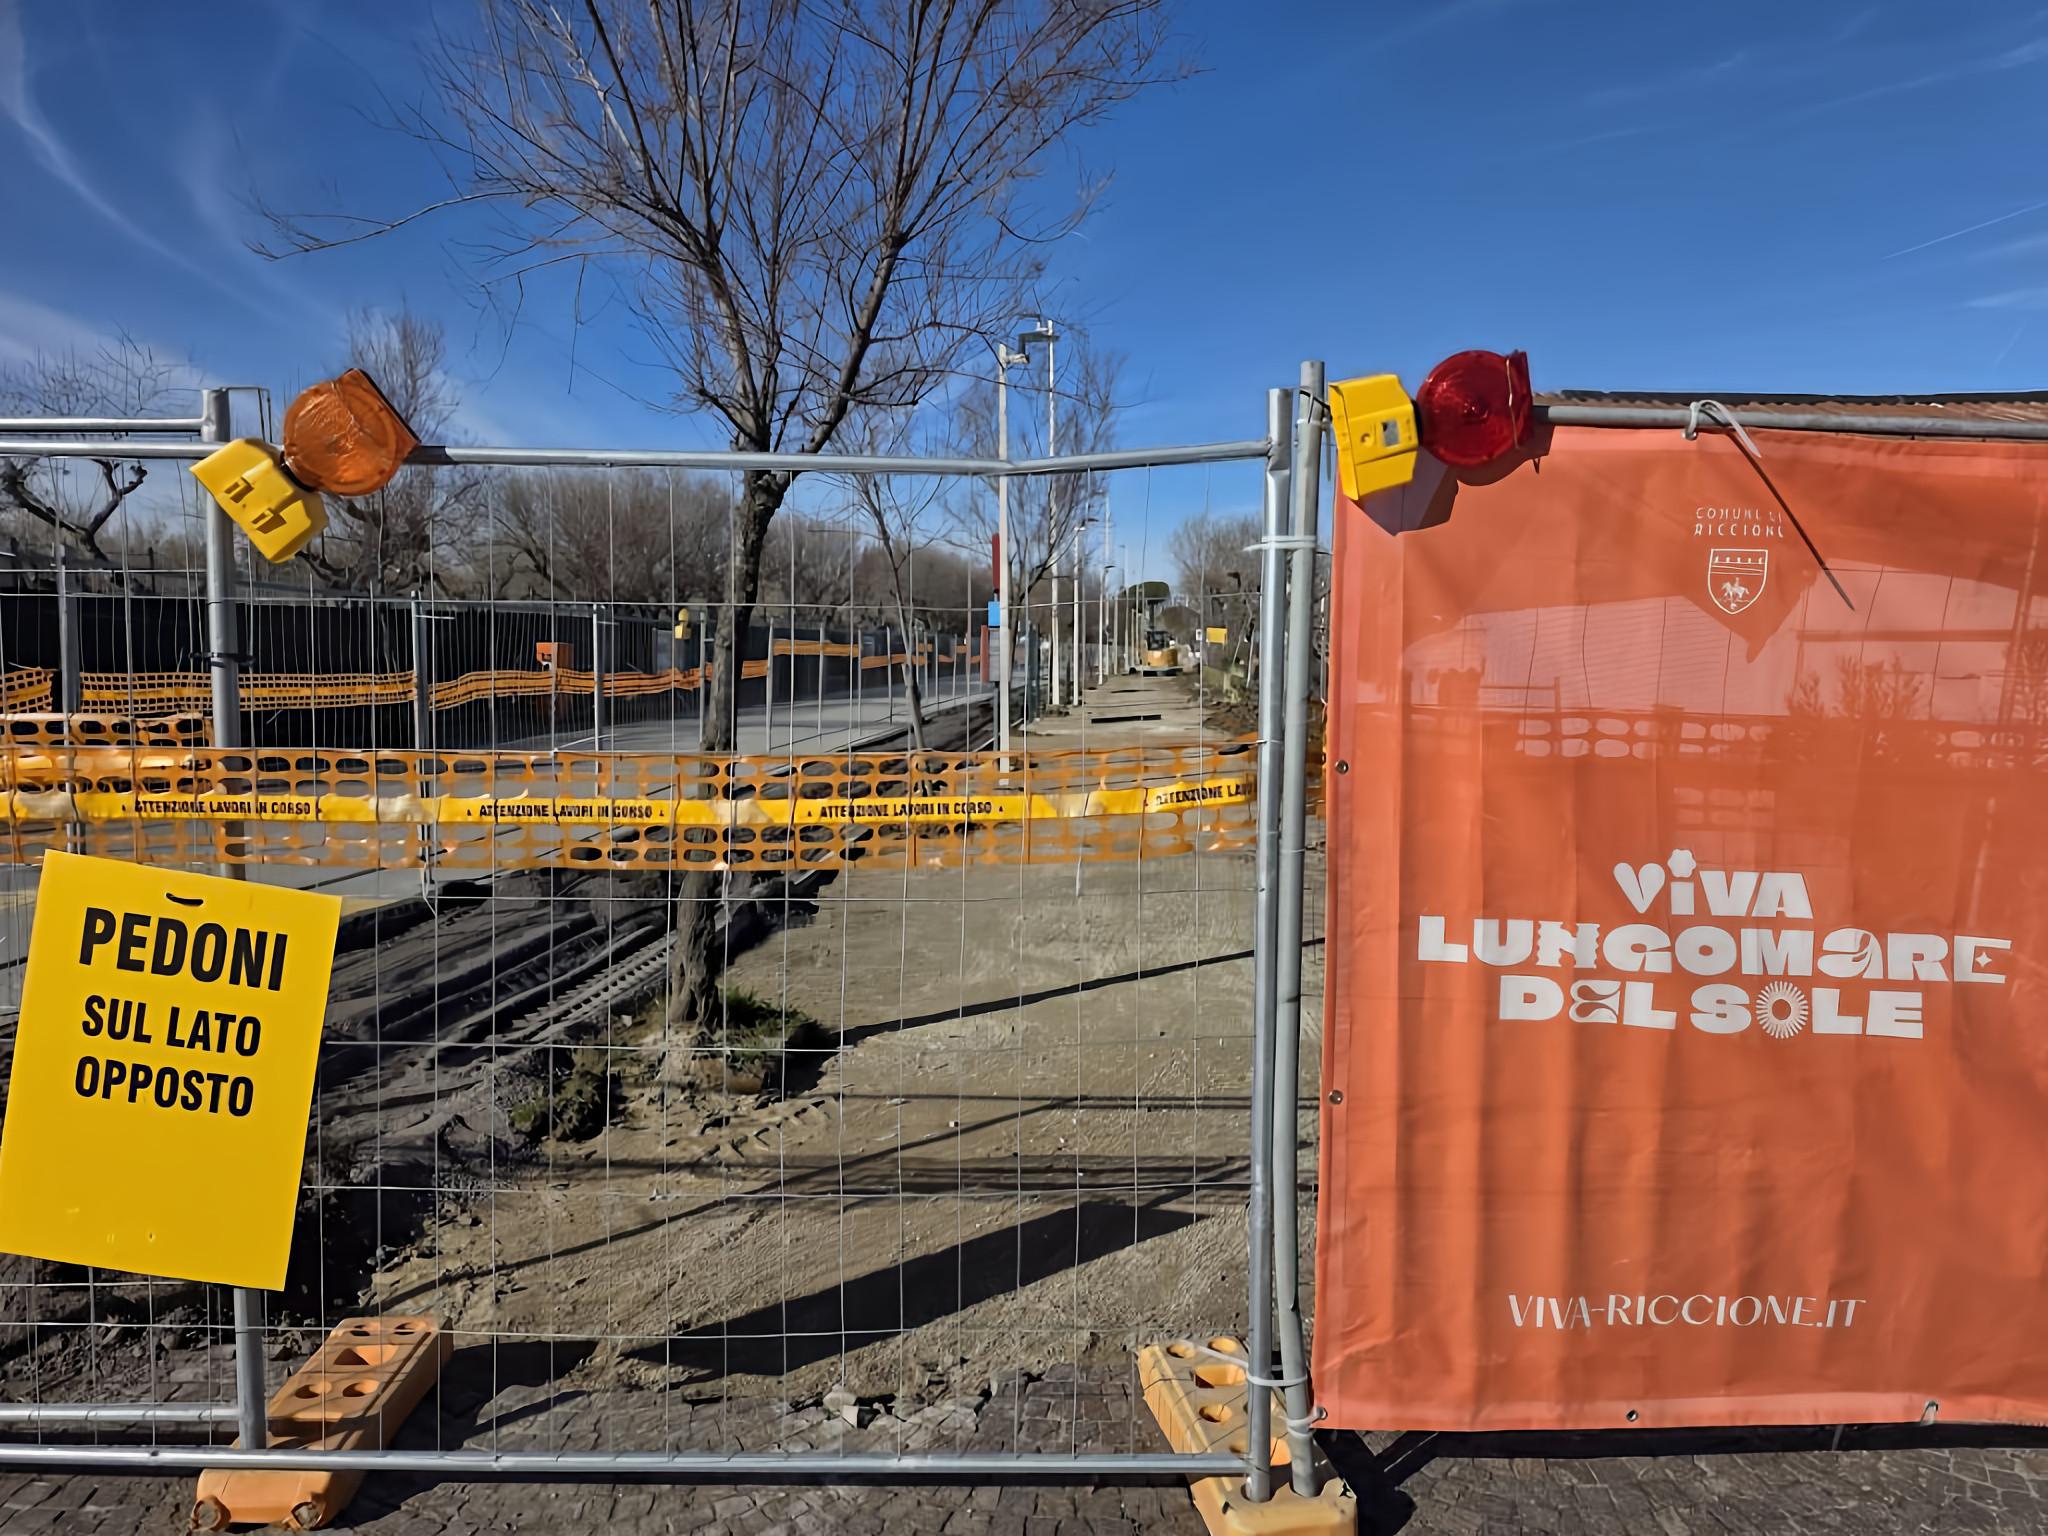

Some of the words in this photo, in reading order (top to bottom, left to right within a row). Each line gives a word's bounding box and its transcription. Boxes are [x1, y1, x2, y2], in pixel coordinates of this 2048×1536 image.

[134, 800, 206, 814] ATTENZIONE
[210, 801, 251, 814] LAVORI
[255, 802, 268, 814] IN
[271, 802, 311, 815] CORSO
[479, 805, 549, 817] ATTENZIONE
[552, 804, 593, 817] LAVORI
[613, 805, 653, 818] CORSO
[820, 804, 889, 818] ATTENZIONE
[953, 801, 993, 815] CORSO
[79, 907, 288, 991] PEDONI
[82, 994, 152, 1044] SUL
[166, 1006, 261, 1057] LATO
[1499, 975, 1677, 1030] DEL
[1690, 980, 1924, 1040] SOLE
[75, 1055, 254, 1118] OPPOSTO
[1508, 1294, 1867, 1330] VIVA-RICCIONE.IT
